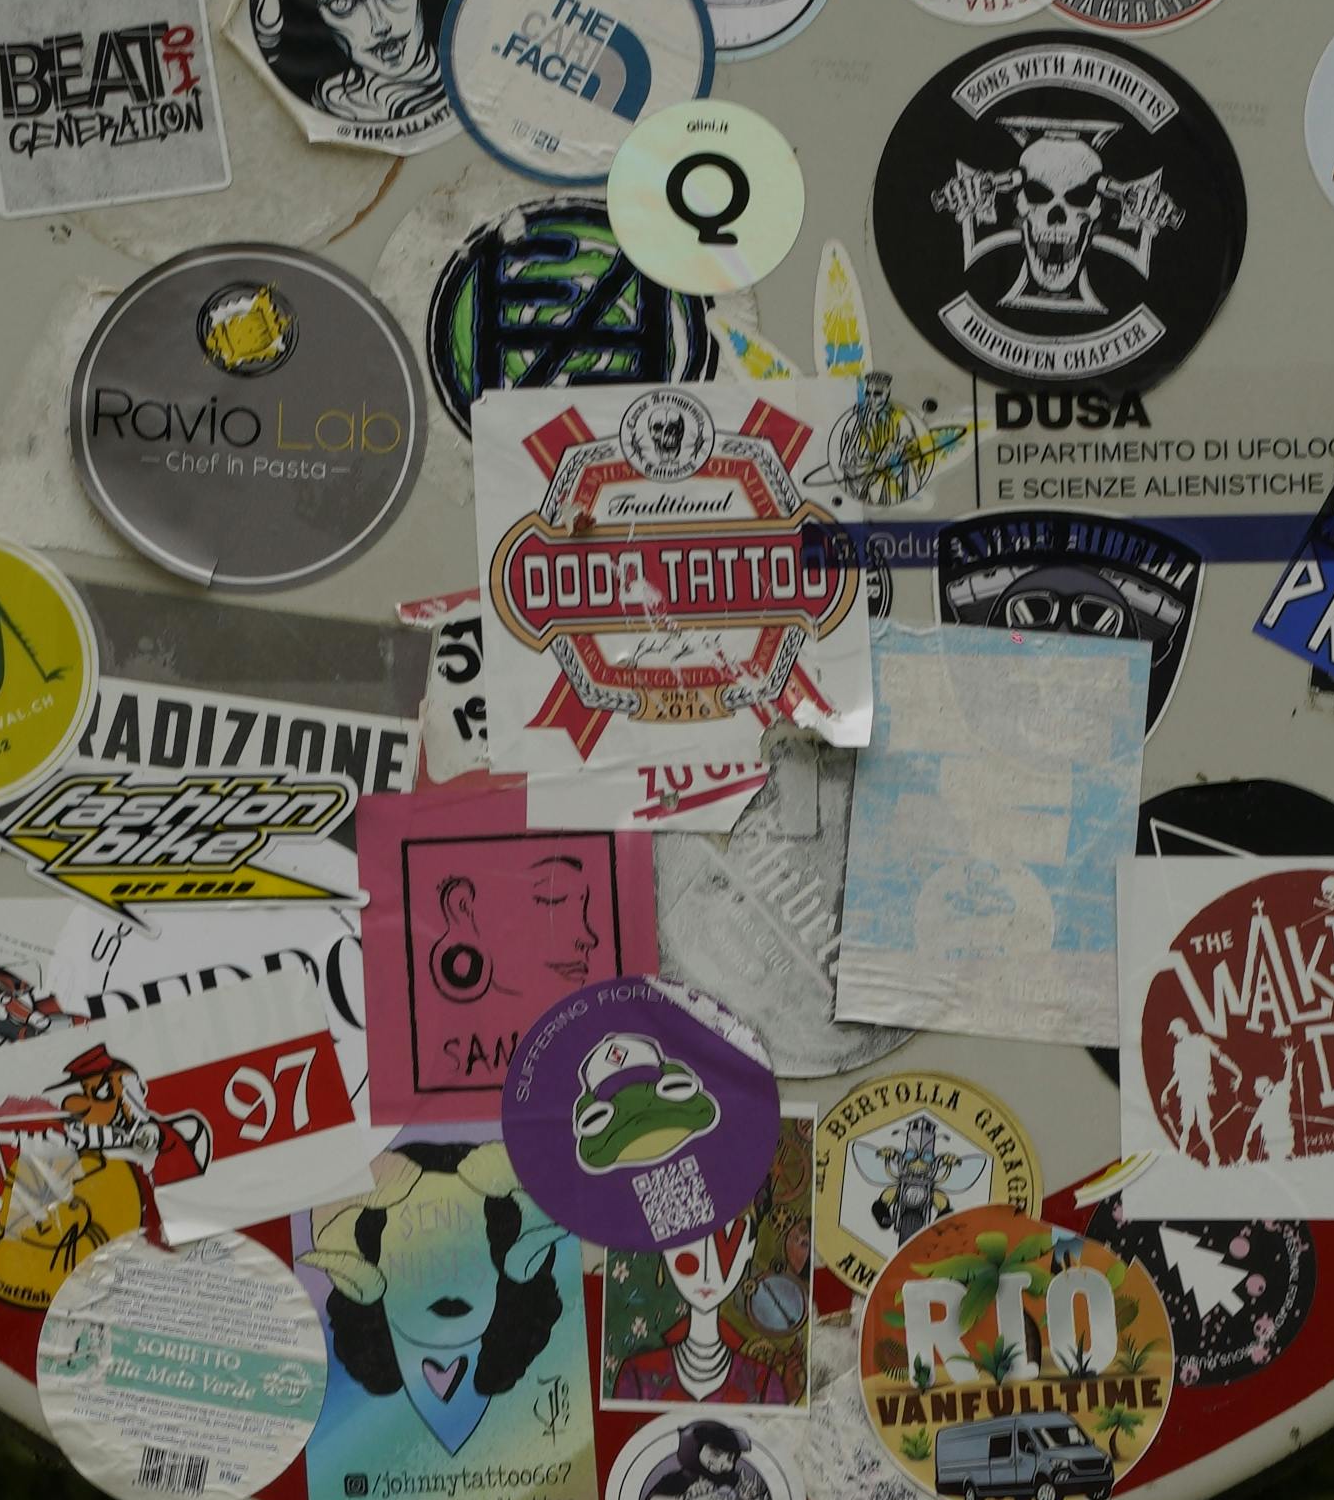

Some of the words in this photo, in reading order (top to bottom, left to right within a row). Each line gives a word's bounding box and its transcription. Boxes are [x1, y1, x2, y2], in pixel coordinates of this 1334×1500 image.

[967, 68, 1011, 104] SONS
[1015, 54, 1066, 80] WITH
[1072, 56, 1168, 120] ARTHRITIS
[8, 87, 205, 160] GENERATION
[665, 151, 751, 247] Q
[963, 316, 1056, 371] IBUPROFEN
[1063, 323, 1147, 370] CHAPTER
[91, 388, 262, 448] Ravio
[276, 400, 402, 455] Lab
[995, 390, 1152, 430] DUSA
[166, 451, 219, 474] Chef
[253, 458, 326, 480] Pasta
[997, 440, 1195, 465] DIPARTIMENTO
[1204, 440, 1229, 460] DI
[607, 490, 734, 516] Traditional
[999, 478, 1015, 500] E
[1023, 476, 1136, 499] SCIENZE
[1144, 472, 1325, 497] ALIENISTICHE
[522, 550, 646, 610] DODO
[660, 542, 830, 604] TATTOO
[655, 704, 711, 719] 2016
[28, 780, 340, 829] fashion
[68, 829, 250, 866] bike
[109, 882, 168, 896] OFF
[175, 881, 256, 896] ROAD
[1189, 929, 1236, 955] THE
[515, 999, 590, 1103] SUFFERING
[223, 1045, 320, 1144] 97
[826, 1081, 962, 1142] BERTOLLA
[900, 1265, 1120, 1388] RIO
[133, 1336, 243, 1371] SORBETTO
[146, 1361, 195, 1389] Mela
[201, 1374, 257, 1401] Verde
[875, 1376, 1164, 1427] VANFULLTIME
[371, 1462, 573, 1499] /johnnytattoo667
